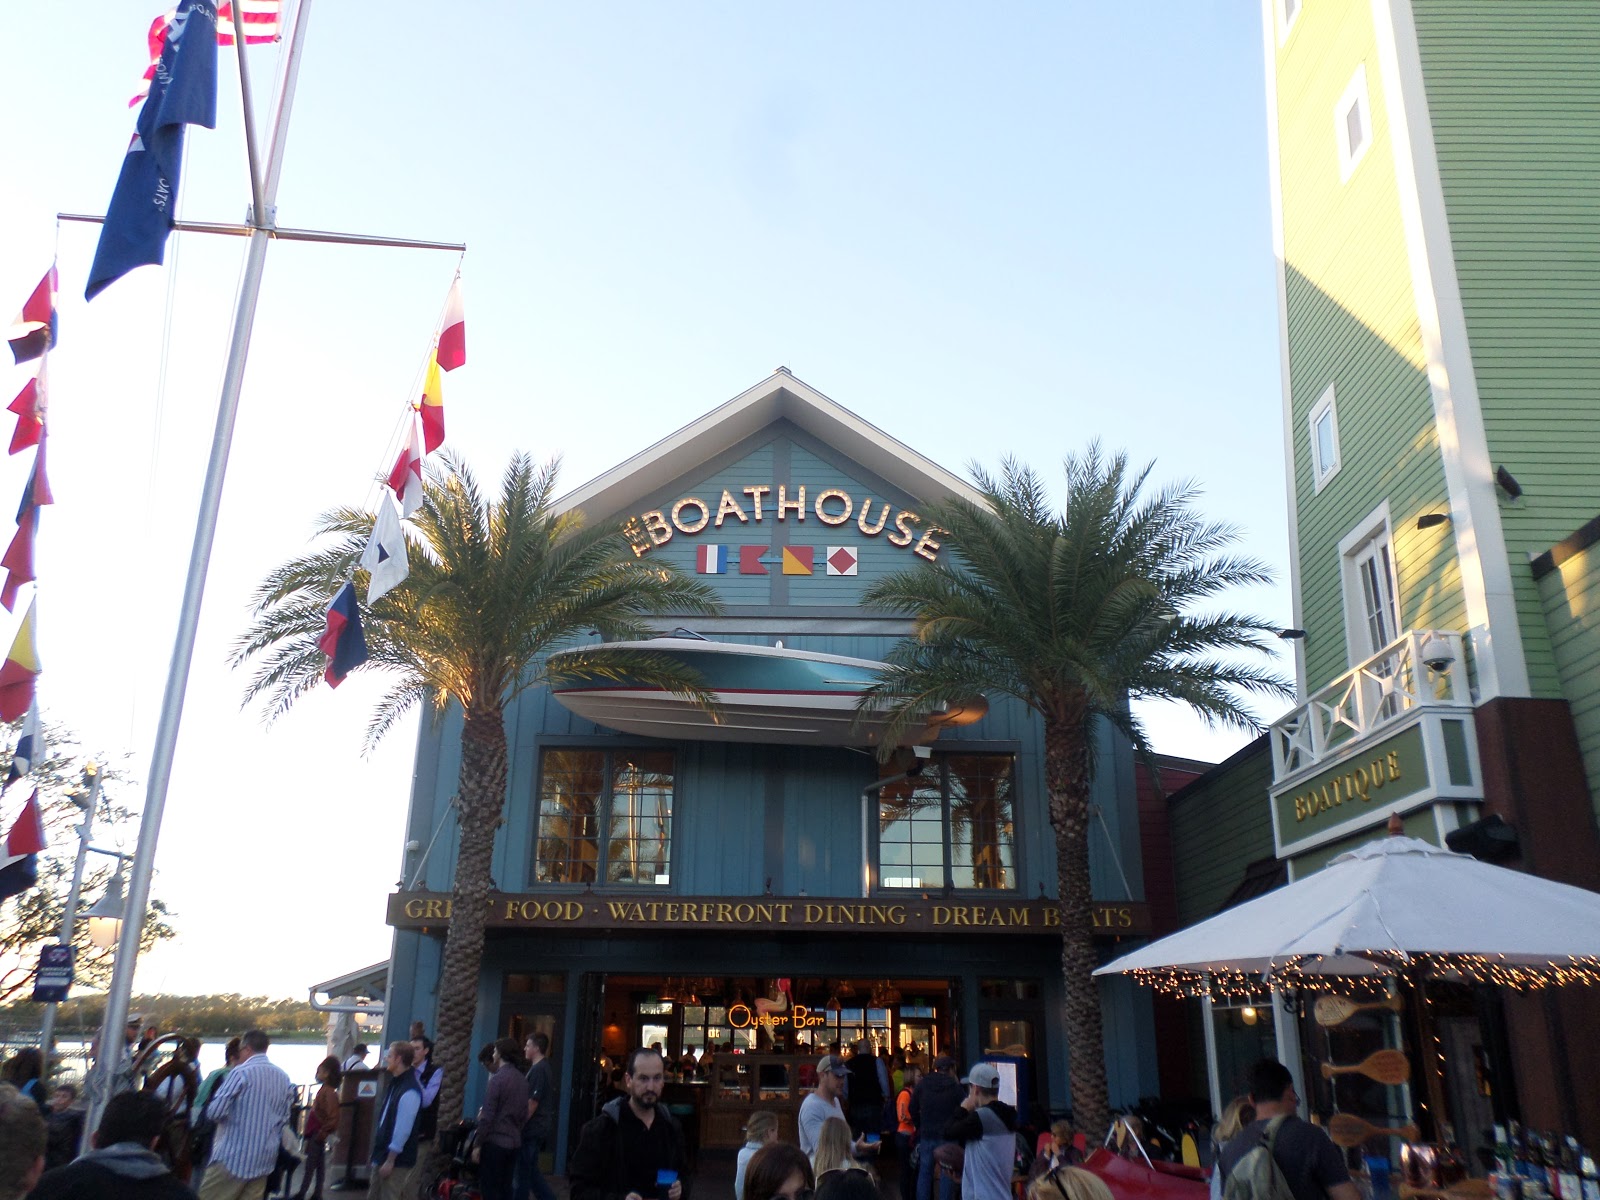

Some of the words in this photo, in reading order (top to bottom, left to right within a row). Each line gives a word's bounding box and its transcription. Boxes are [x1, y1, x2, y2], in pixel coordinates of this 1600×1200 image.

[640, 484, 950, 562] BOATHOUSE
[1295, 750, 1400, 823] BOATIQUE
[504, 900, 584, 921] FOOD
[607, 902, 793, 923] WATERFRONT
[804, 904, 907, 926] DINING
[932, 906, 1030, 927] DREAM
[728, 1004, 788, 1029] Oyster
[792, 1005, 825, 1028] Bar
